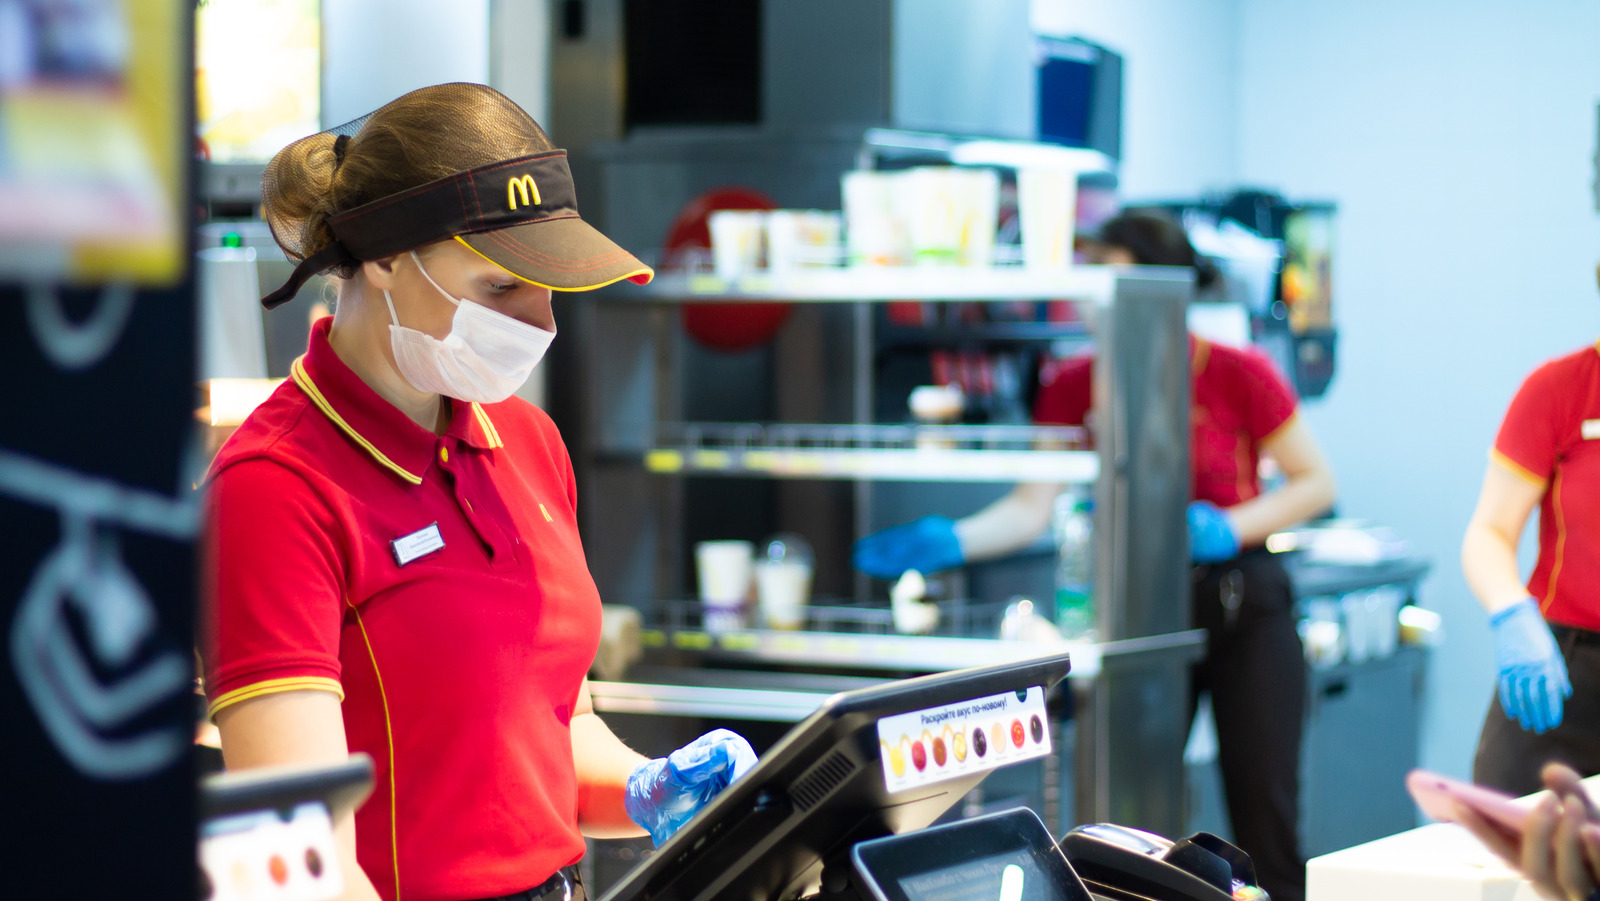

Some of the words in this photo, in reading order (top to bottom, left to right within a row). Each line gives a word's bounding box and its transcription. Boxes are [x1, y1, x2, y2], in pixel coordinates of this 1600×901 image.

[508, 175, 541, 210] M
[921, 709, 955, 724] Раскройте
[957, 707, 971, 719] вкус
[972, 696, 1007, 713] по-новому!
